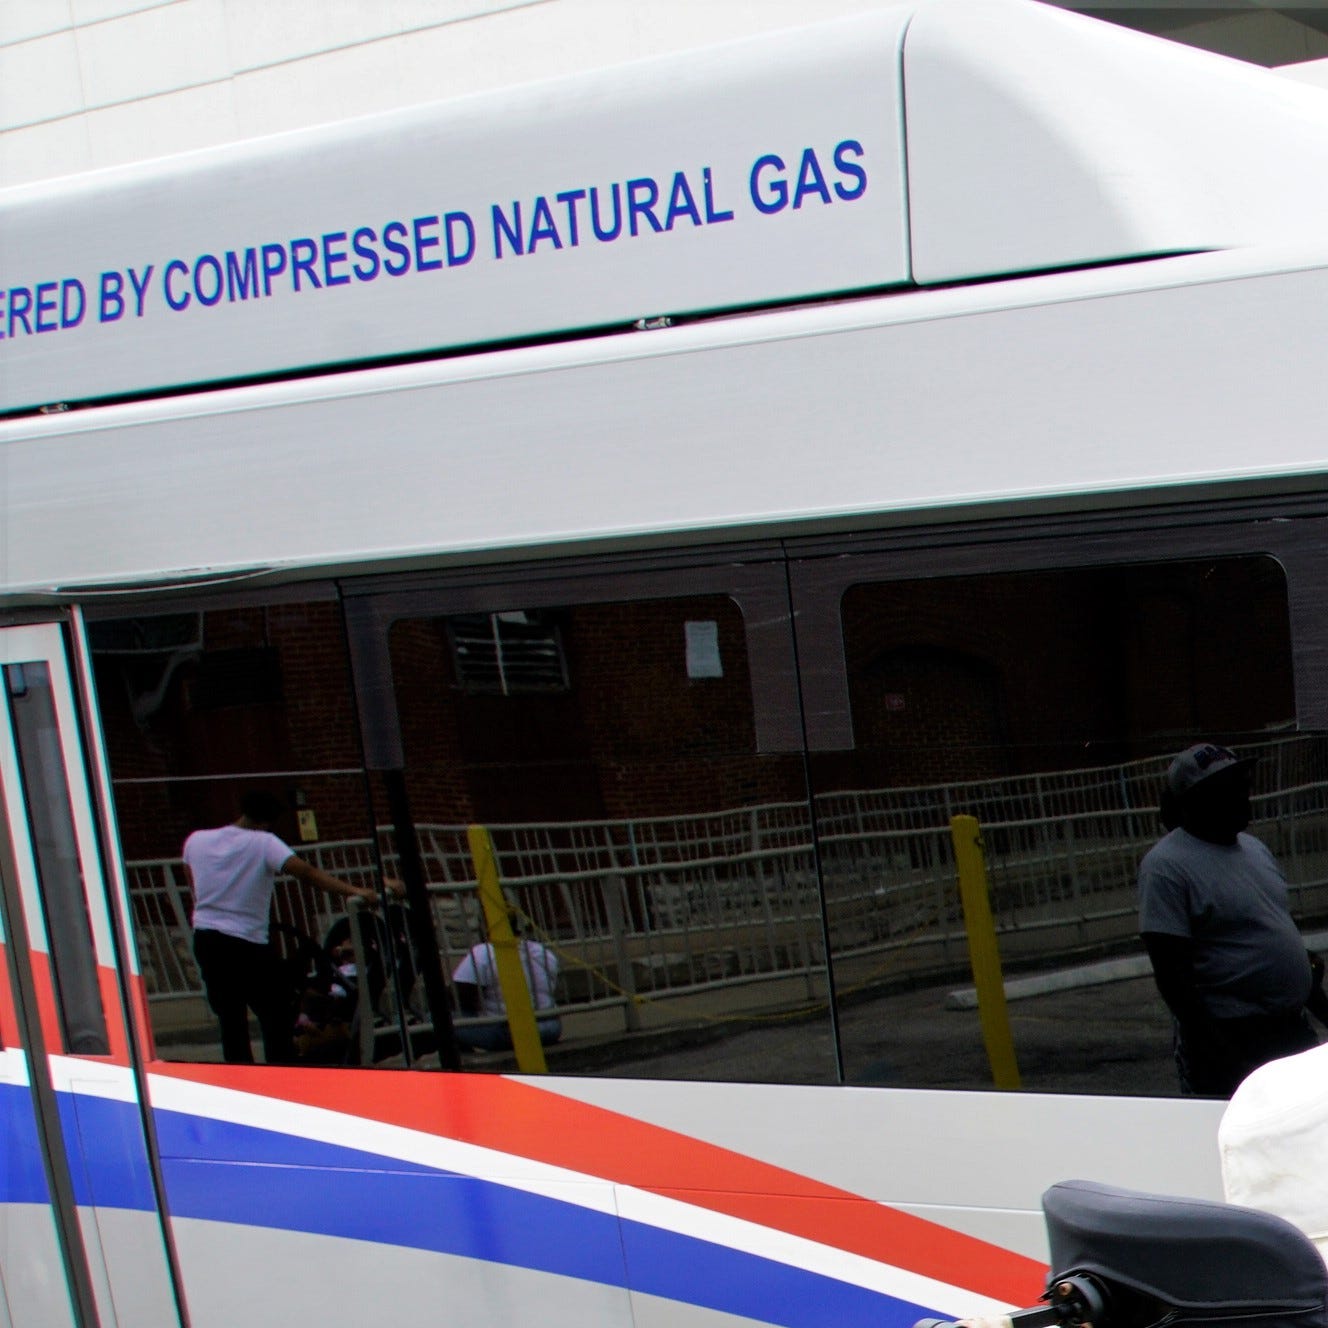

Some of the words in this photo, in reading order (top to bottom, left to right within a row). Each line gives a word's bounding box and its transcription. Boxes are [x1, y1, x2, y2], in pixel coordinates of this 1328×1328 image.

[98, 265, 153, 322] BY
[163, 211, 477, 311] COMPRESSED
[490, 168, 734, 260] NATURAL
[748, 139, 868, 216] GAS
